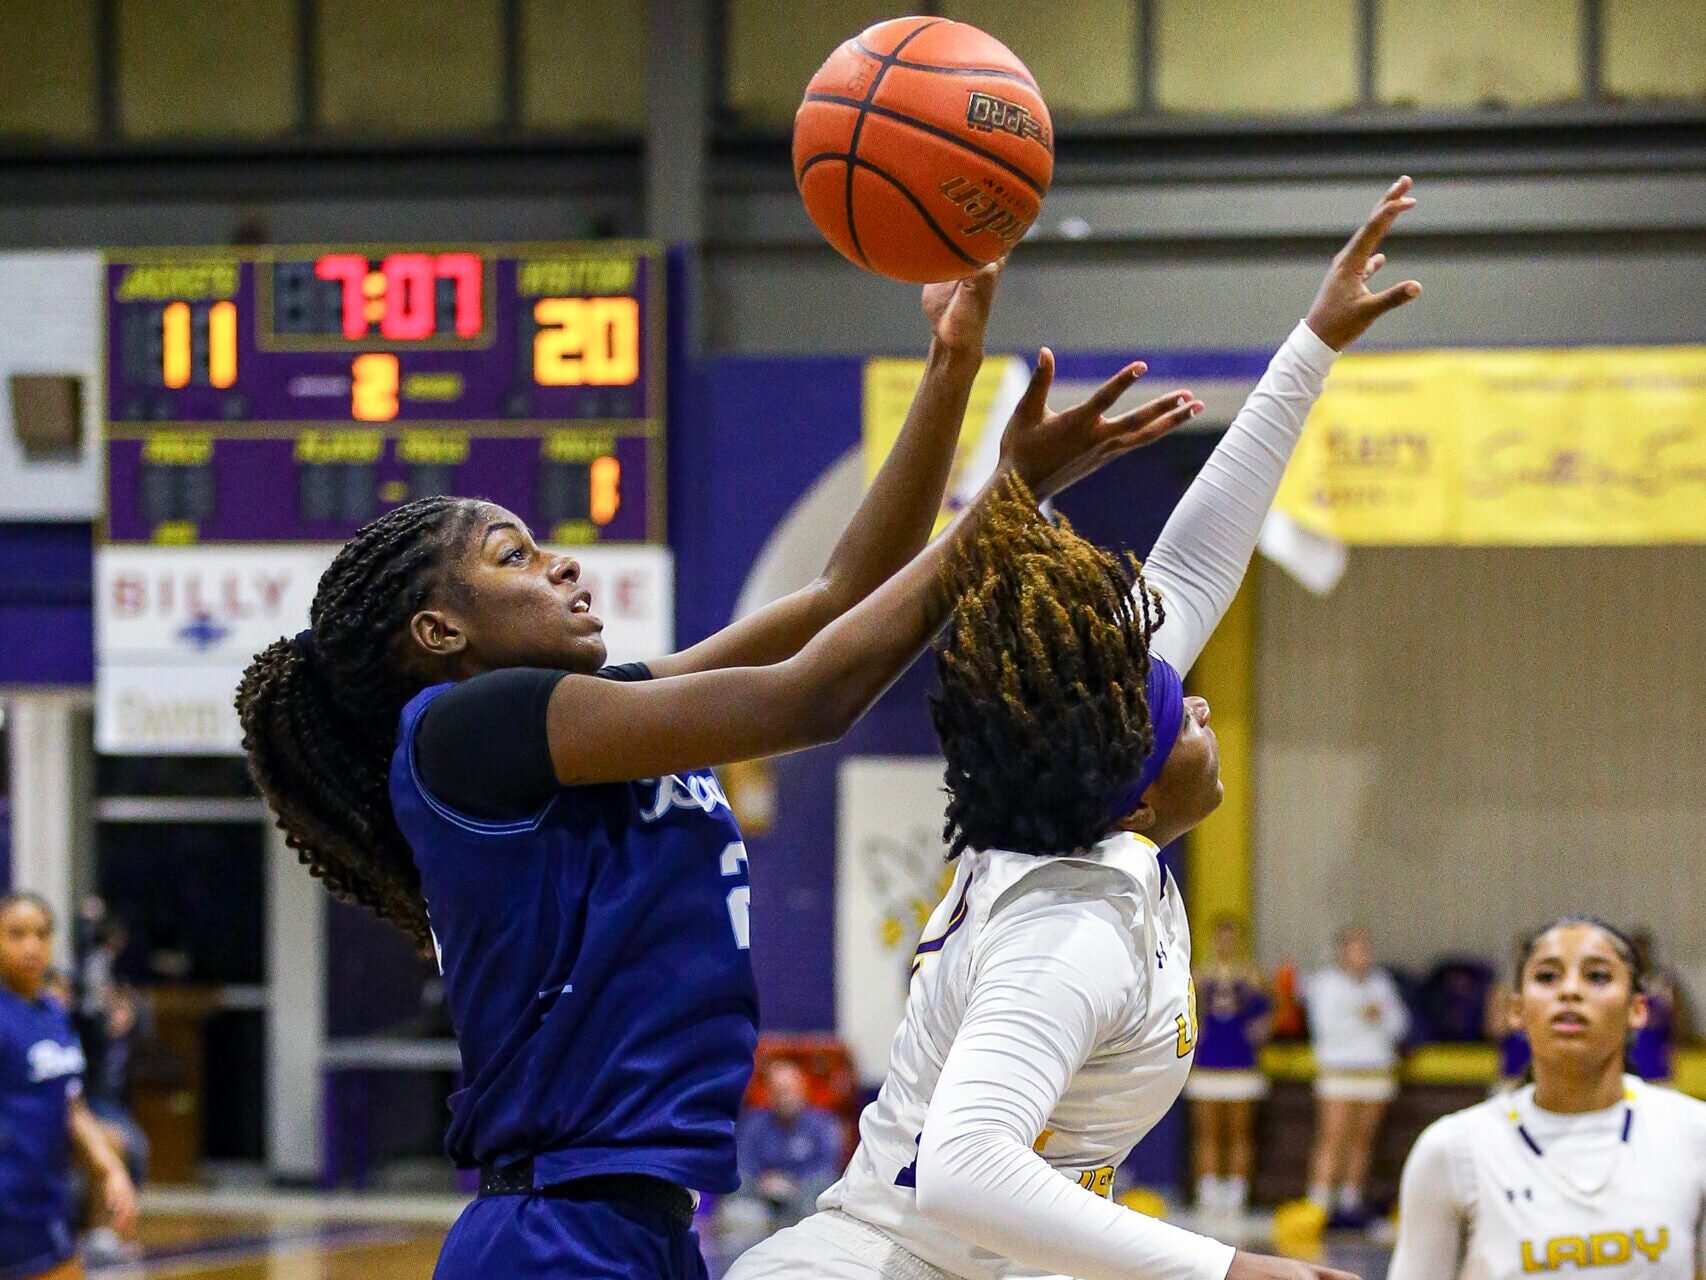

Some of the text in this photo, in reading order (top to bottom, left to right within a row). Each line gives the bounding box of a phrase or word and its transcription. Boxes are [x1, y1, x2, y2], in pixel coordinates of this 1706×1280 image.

[315, 252, 483, 340] 7:07
[162, 300, 237, 388] 11
[533, 297, 639, 386] 20
[1520, 1225, 1669, 1274] LADY
